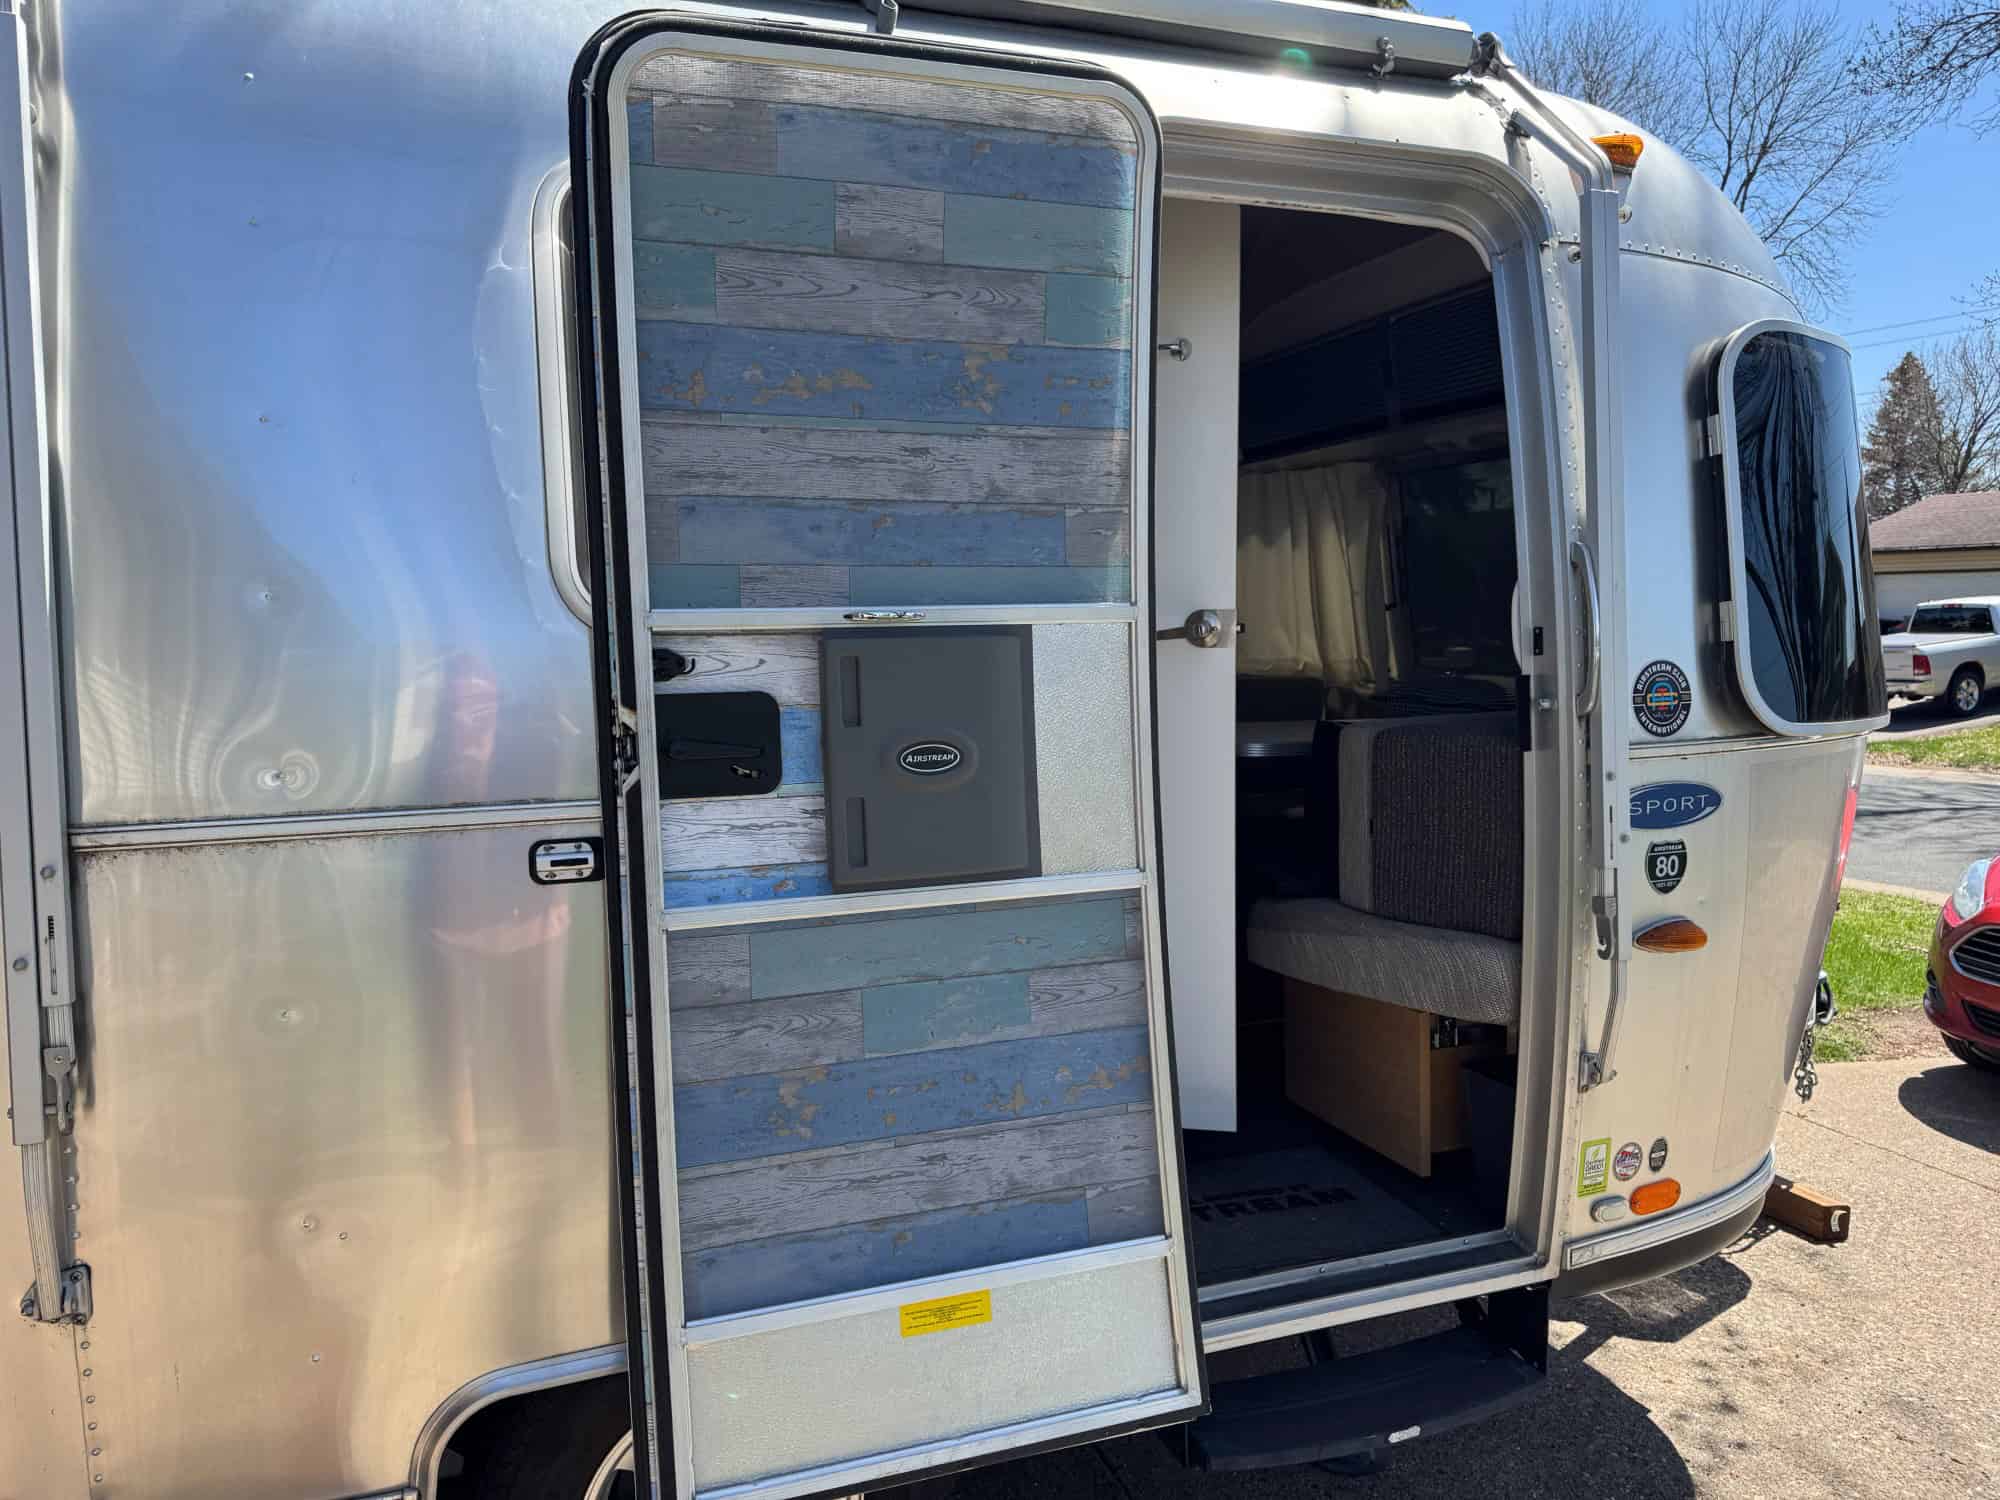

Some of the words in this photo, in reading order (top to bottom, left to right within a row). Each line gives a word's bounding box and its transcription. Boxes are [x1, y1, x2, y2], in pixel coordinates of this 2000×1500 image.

[1636, 663, 1672, 690] AIRSTREAM
[1672, 668, 1687, 688] CLUB
[1639, 710, 1687, 735] INTERNATIONAL
[905, 753, 955, 763] AIRSTREAM
[1630, 794, 1709, 816] SPORT
[1656, 855, 1679, 877] 80
